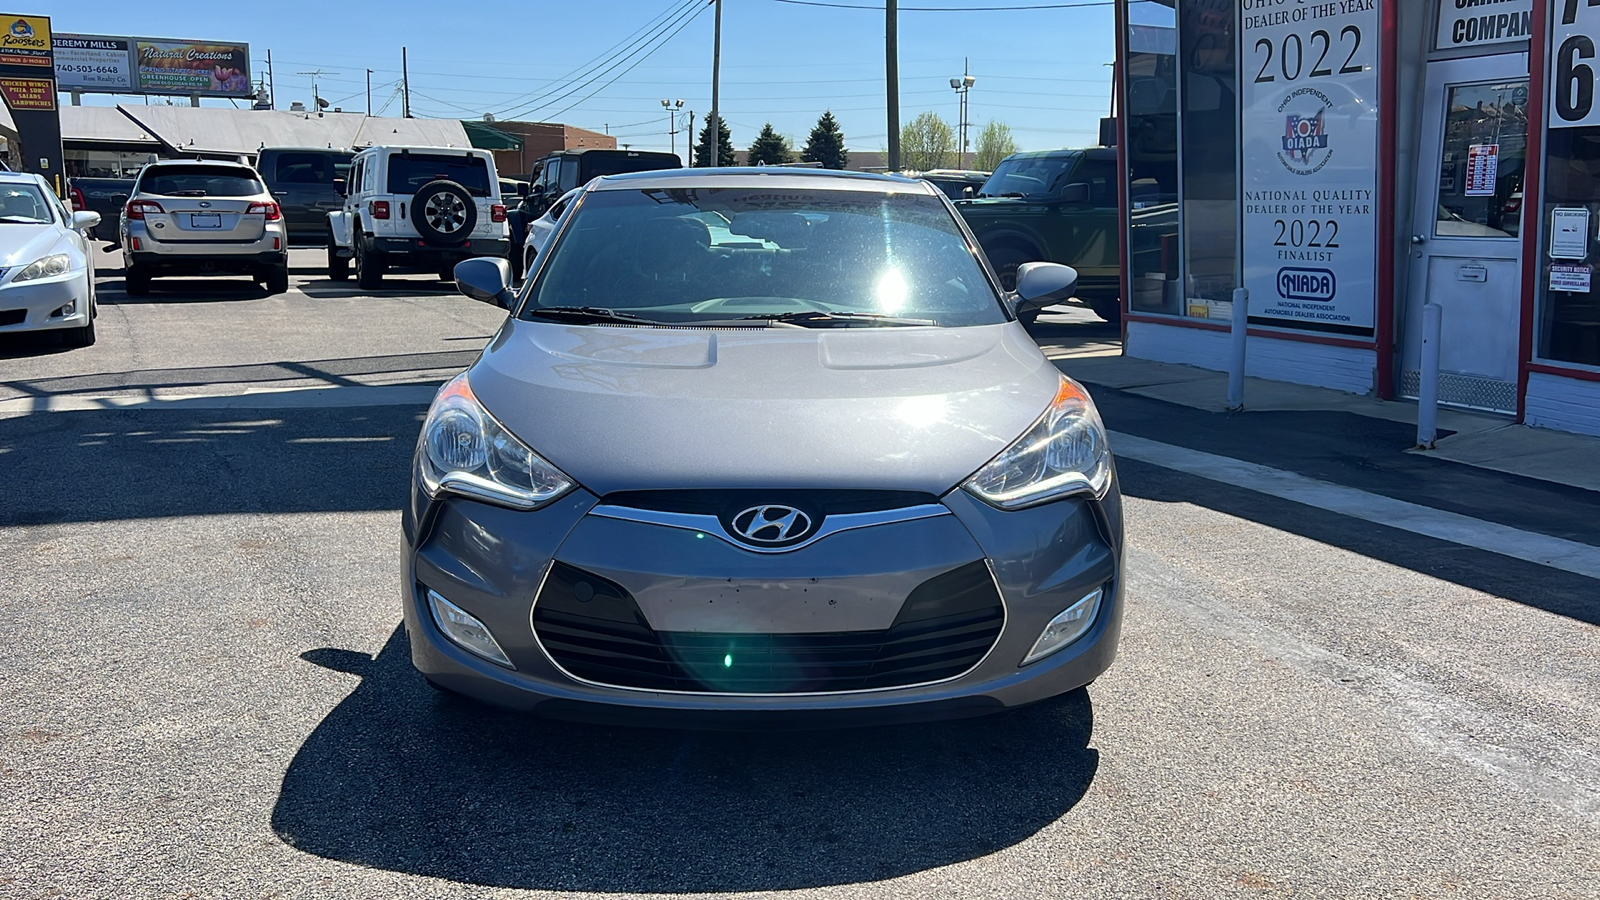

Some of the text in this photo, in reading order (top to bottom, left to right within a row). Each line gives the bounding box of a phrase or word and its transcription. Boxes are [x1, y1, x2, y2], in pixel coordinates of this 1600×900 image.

[1245, 0, 1374, 29] DEALER OF THE YEAR
[1, 34, 45, 47] Roosters
[53, 39, 117, 49] JEREMY MILLS
[142, 47, 233, 61] Natural Creations
[1253, 25, 1362, 83] 2022
[56, 64, 118, 74] 740-503-6648
[1556, 35, 1595, 121] 6
[1277, 87, 1333, 113] OHIO INDEPENDENT
[1287, 136, 1320, 149] OIADA
[1245, 190, 1372, 202] NATIONAL QUALITY
[1246, 205, 1370, 214] DEALER OF THE YEAR
[1273, 219, 1339, 248] 2022
[1278, 250, 1333, 261] FINALIST
[1282, 274, 1329, 294] NIADA
[1277, 301, 1335, 312] NATIONAL INDEPENDENT
[1264, 309, 1350, 321] AUTOMOBILE DEALERS ASSOCIATION
